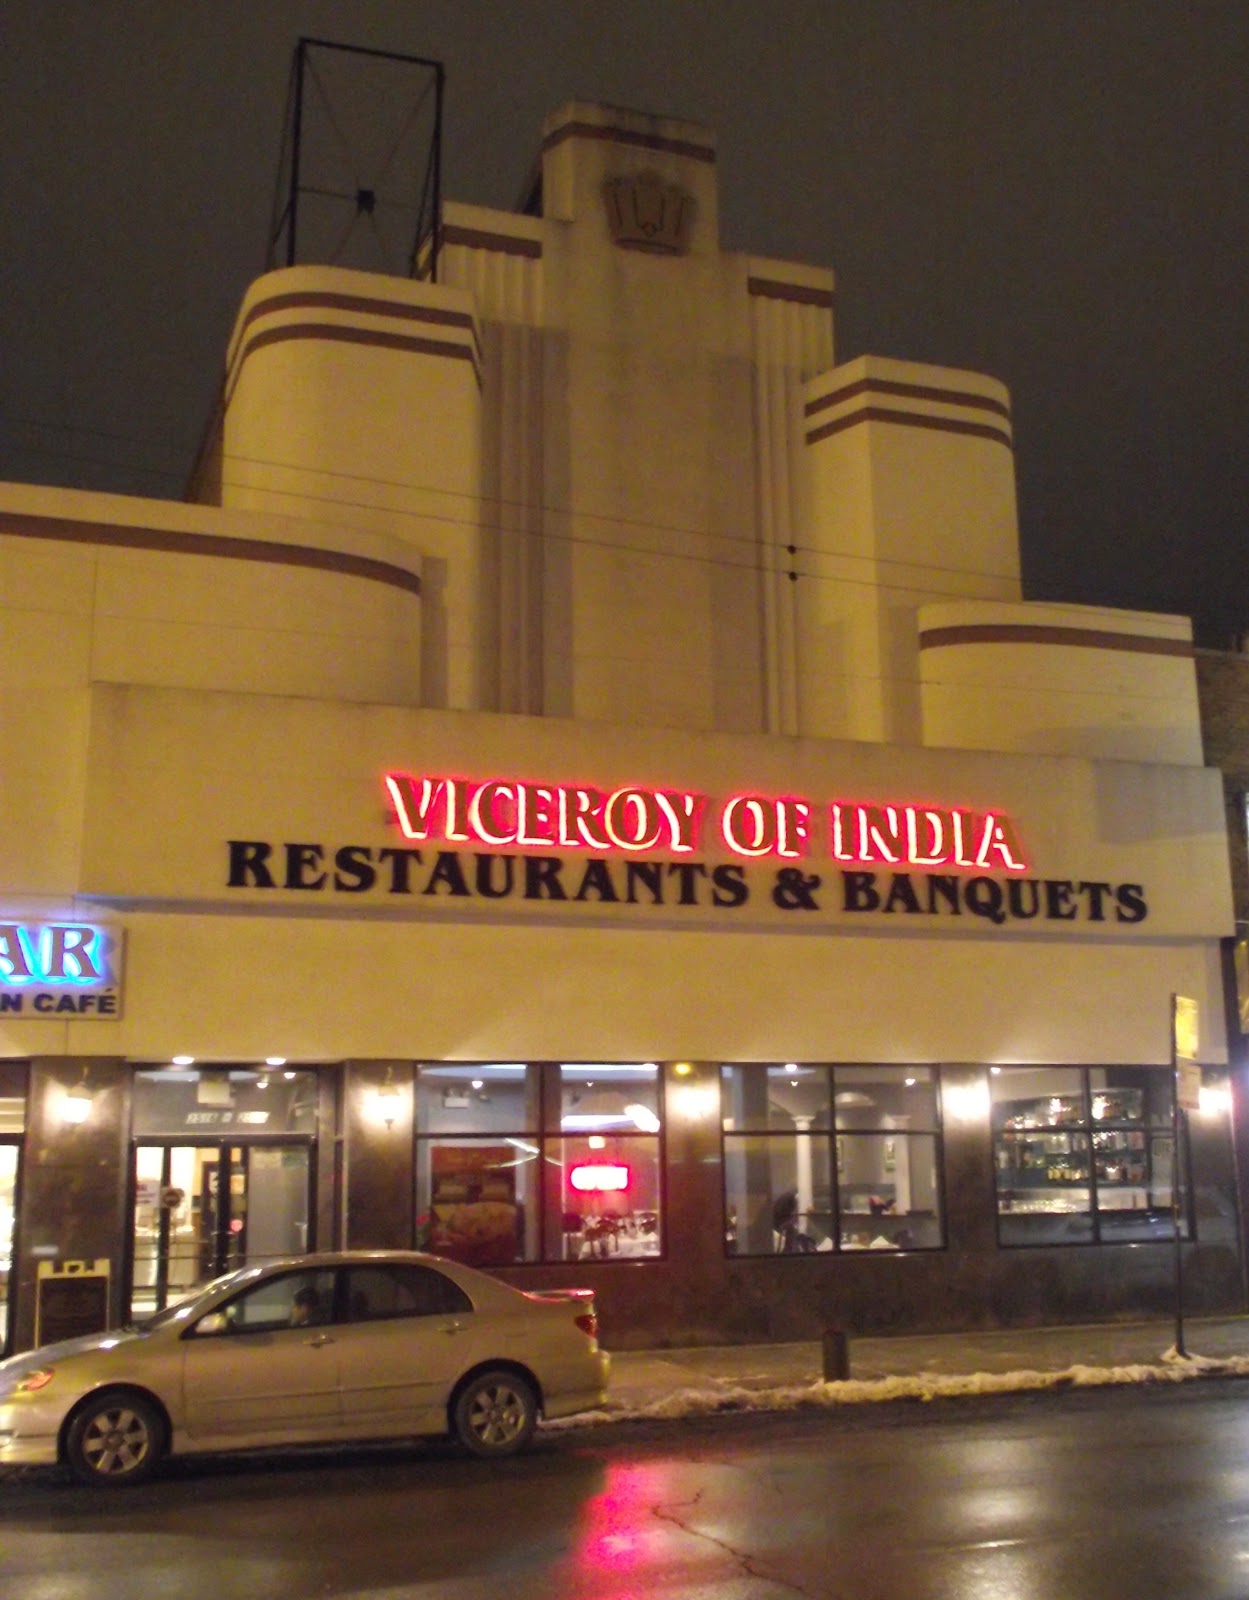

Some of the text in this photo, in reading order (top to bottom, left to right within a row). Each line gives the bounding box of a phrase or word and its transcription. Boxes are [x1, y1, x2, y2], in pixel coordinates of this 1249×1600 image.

[384, 773, 1027, 871] VICEROY OF INDIA
[226, 840, 1148, 925] RESTAURANTS & BANQUETS
[34, 987, 116, 1014] CAFÉ
